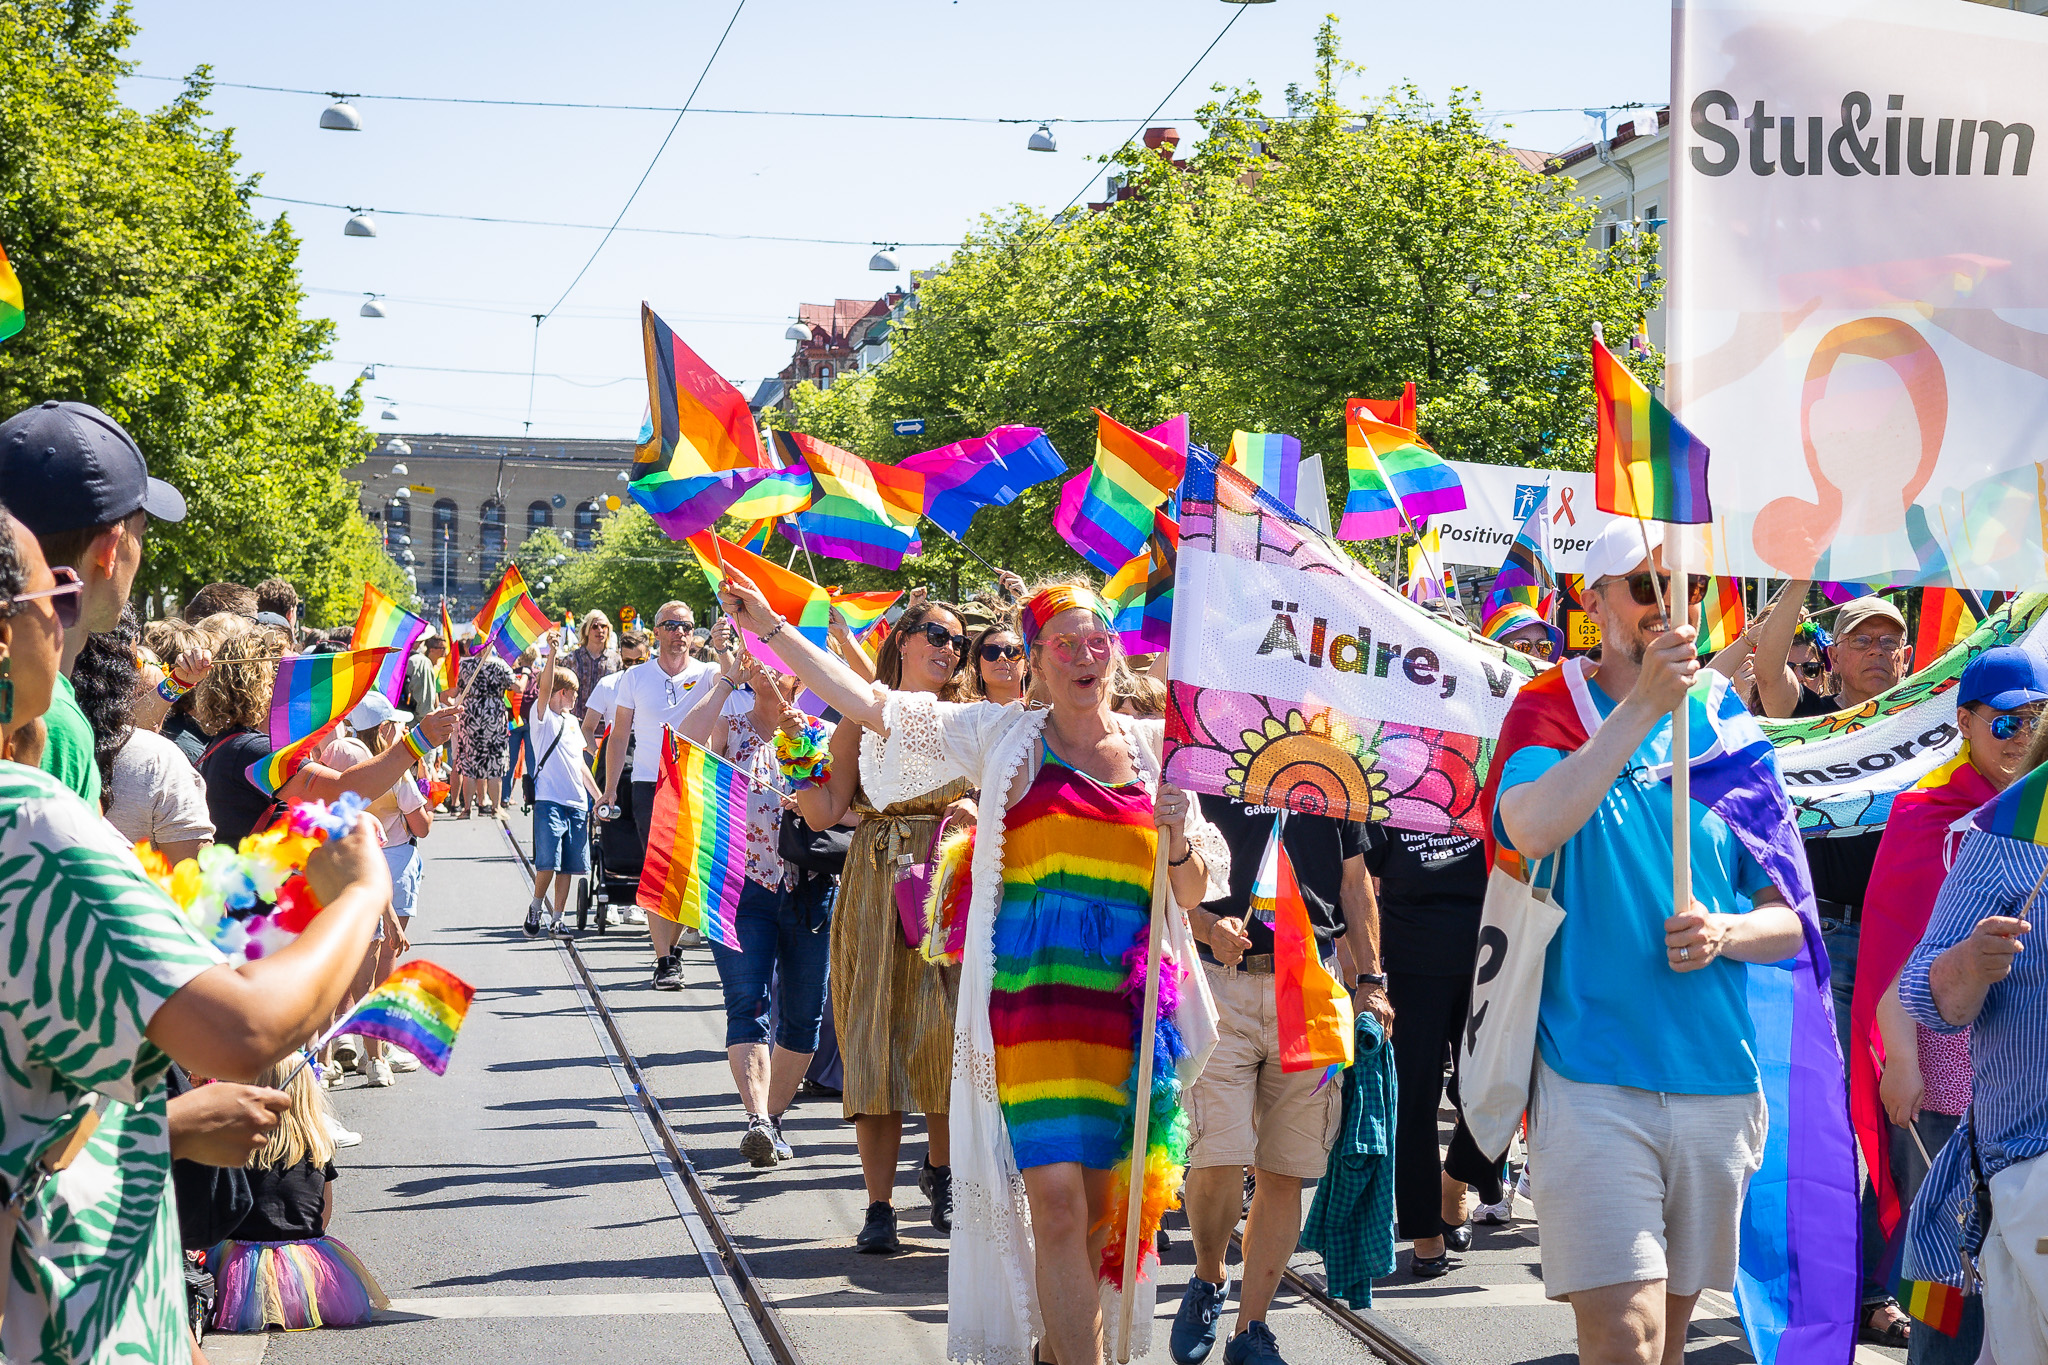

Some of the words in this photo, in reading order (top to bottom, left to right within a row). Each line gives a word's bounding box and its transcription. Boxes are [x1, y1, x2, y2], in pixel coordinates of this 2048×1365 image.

[1689, 89, 2035, 177] Stu&ium
[1439, 523, 1515, 546] Positiva
[1256, 600, 1458, 699] Äldre,
[1407, 842, 1427, 852] om
[1420, 848, 1454, 862] Fråga
[385, 1005, 413, 1021] SHOP
